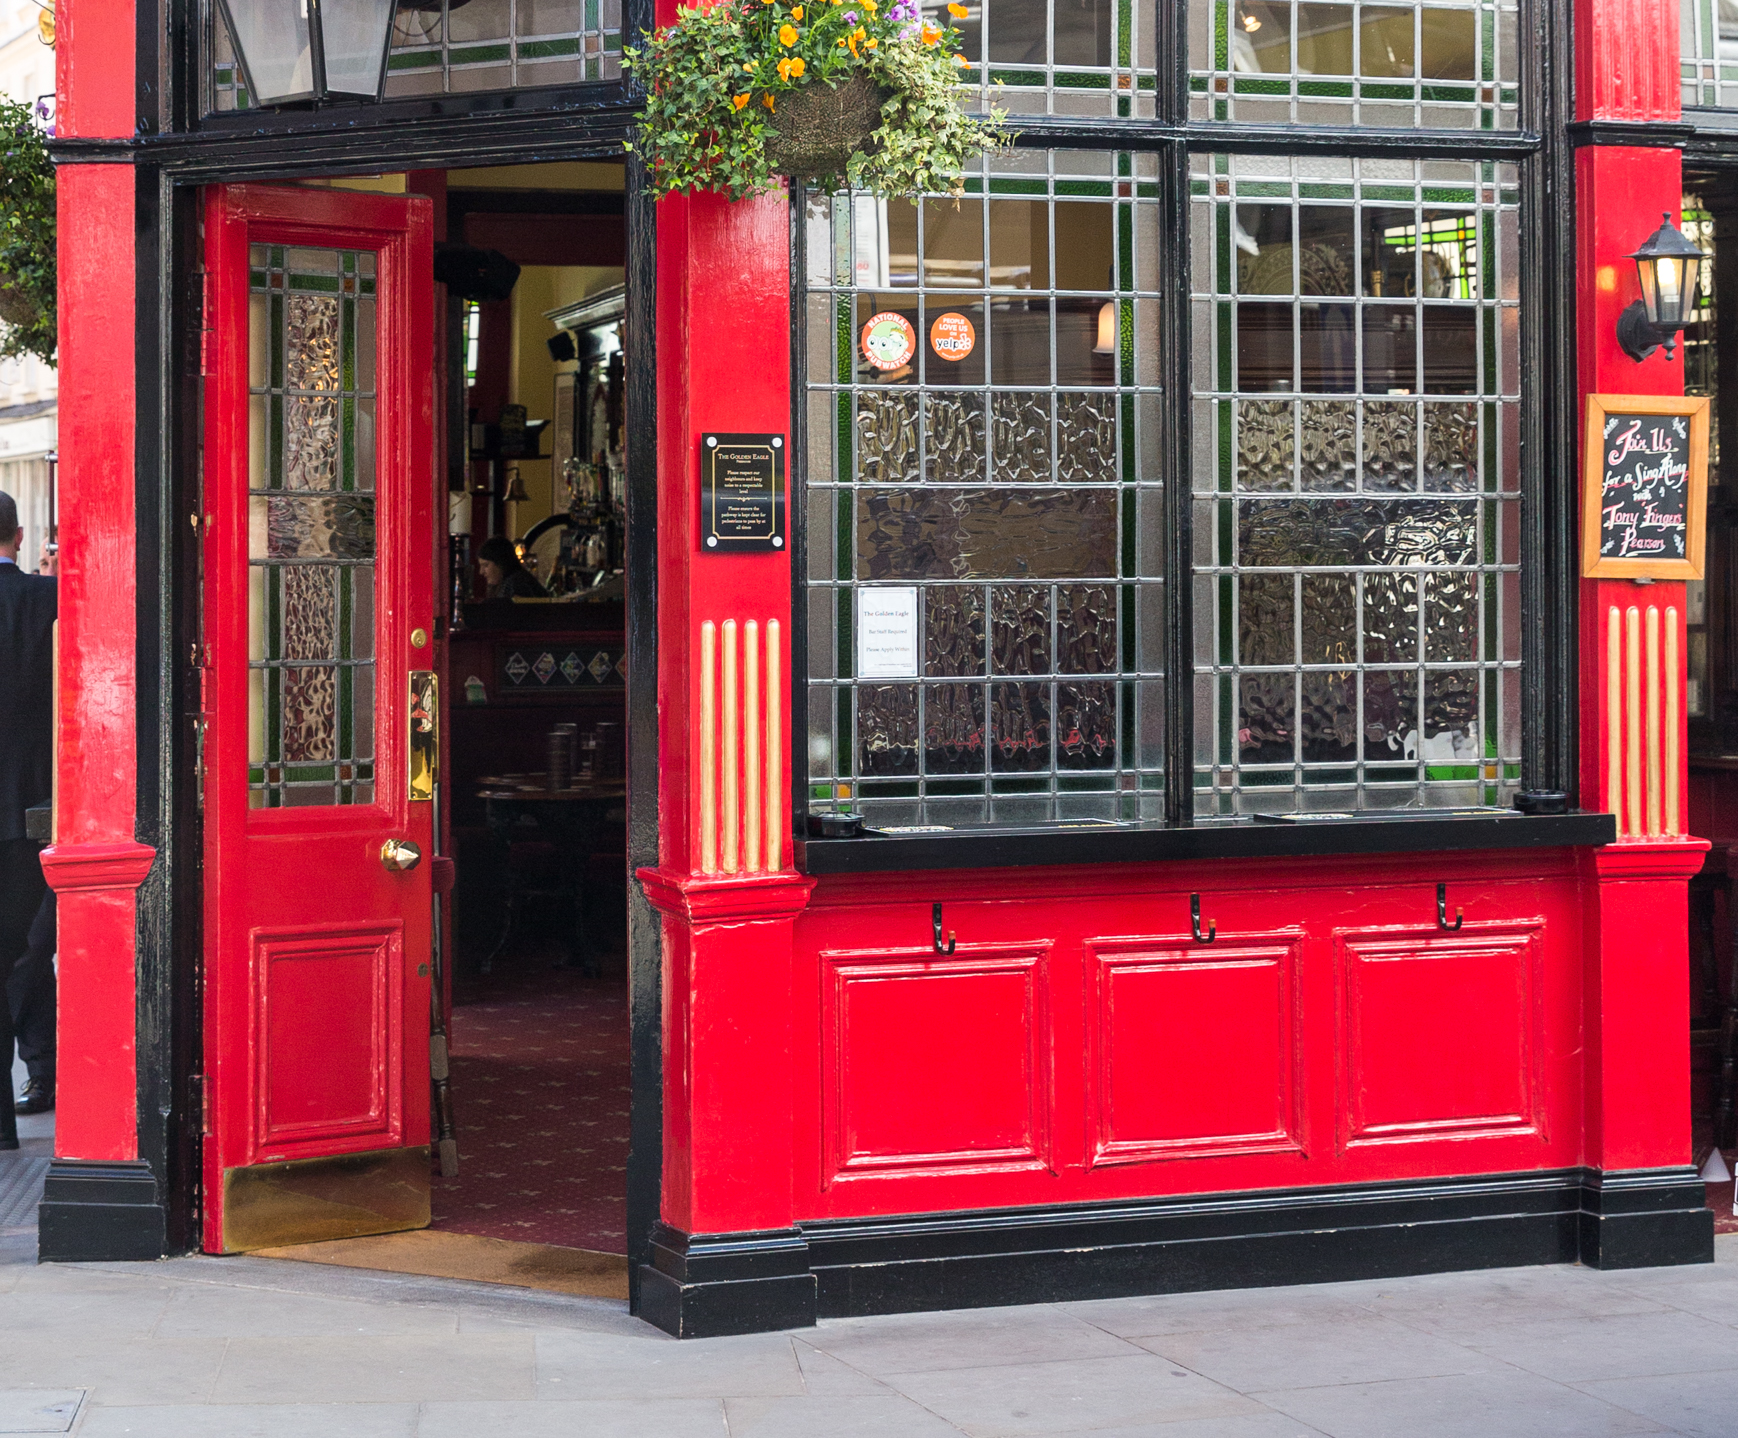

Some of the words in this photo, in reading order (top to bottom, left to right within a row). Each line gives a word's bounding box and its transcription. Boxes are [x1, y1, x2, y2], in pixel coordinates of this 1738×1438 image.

[867, 313, 909, 331] NATIONAL
[938, 324, 958, 332] LOVE
[958, 324, 968, 332] US
[942, 317, 965, 325] PEOPLE
[936, 338, 960, 350] yelp
[864, 350, 912, 370] PUBWATCH
[1607, 419, 1648, 466] Join
[1649, 427, 1673, 452] Us
[1601, 470, 1622, 497] for
[1623, 473, 1634, 484] a
[1632, 488, 1653, 502] with
[1602, 501, 1640, 531] Tony
[1618, 526, 1667, 557] Pearson
[895, 610, 910, 618] Eagle
